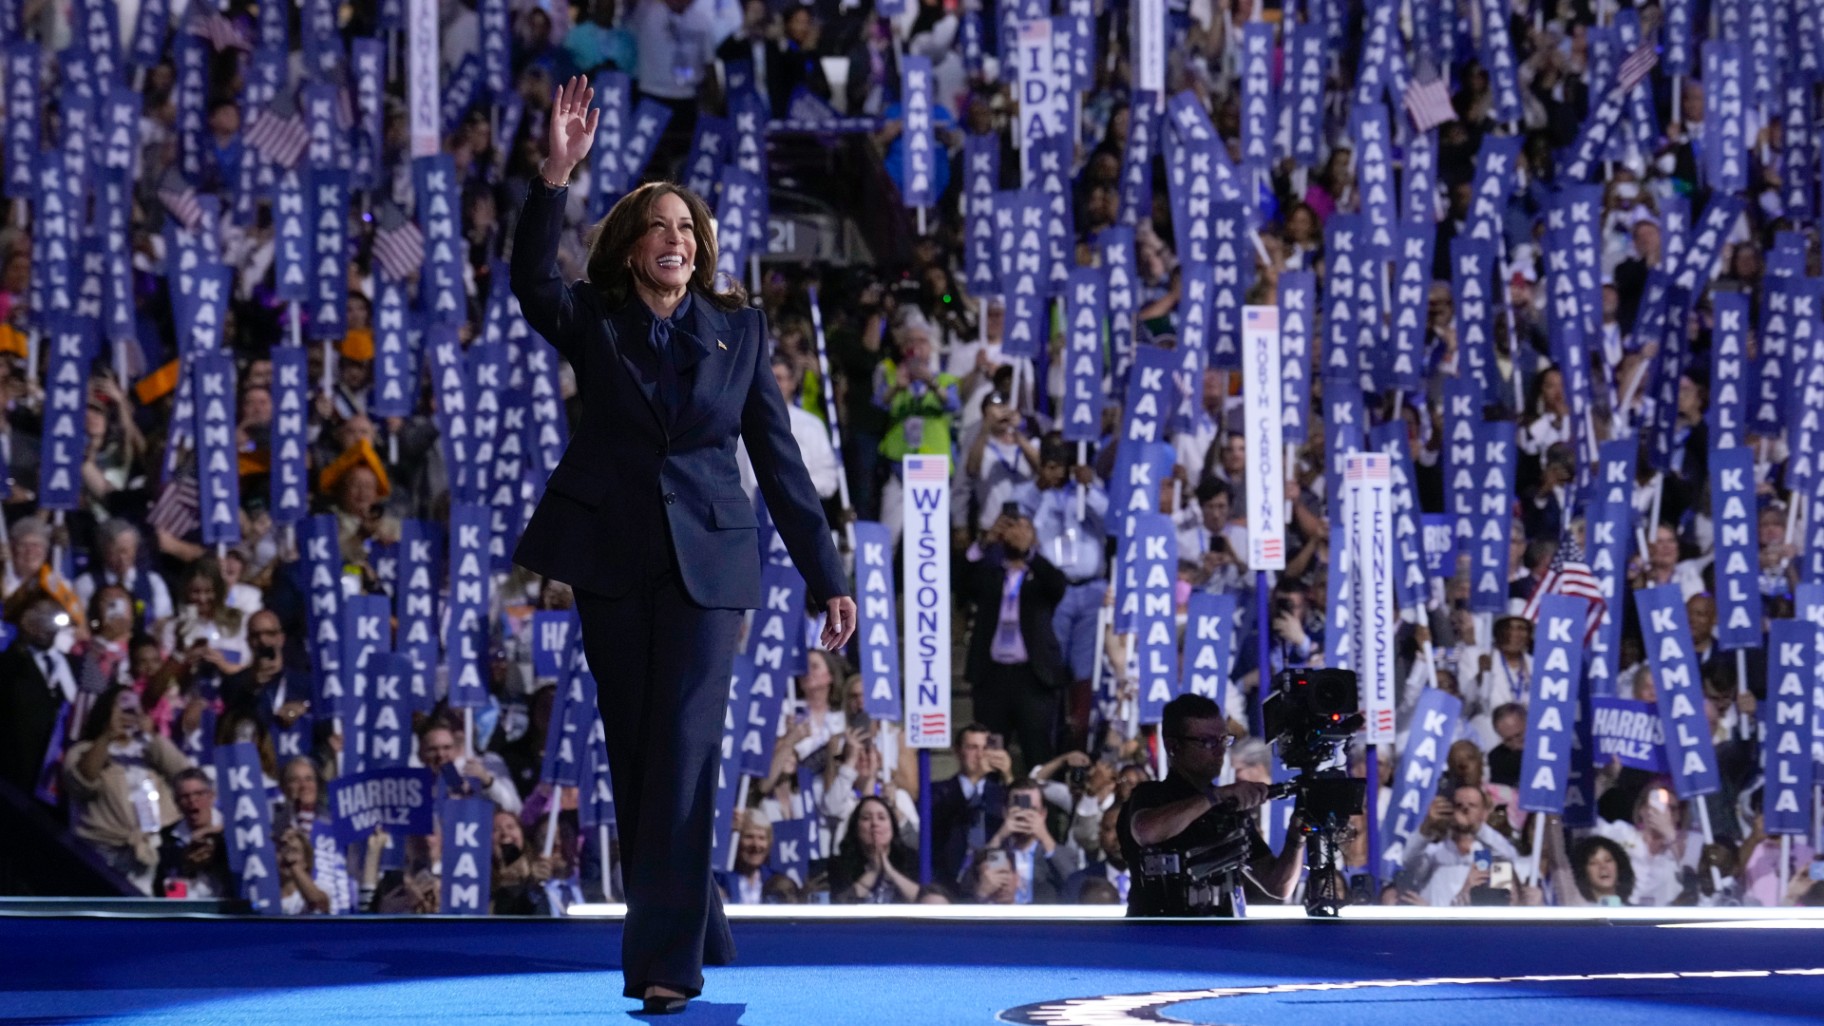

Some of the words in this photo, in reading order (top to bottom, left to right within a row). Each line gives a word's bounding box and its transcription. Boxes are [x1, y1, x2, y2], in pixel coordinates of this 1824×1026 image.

[483, 0, 506, 92] MALA
[1025, 47, 1047, 139] IDA
[1248, 36, 1268, 155] KAMALA
[1297, 38, 1320, 151] KAMALA
[1358, 5, 1392, 103] KAMAL
[1486, 0, 1518, 106] AMALA
[1751, 0, 1771, 92] AMALA
[12, 55, 33, 183] KAMALA
[600, 87, 621, 193] KAMAL
[622, 117, 657, 173] KAM
[688, 132, 720, 199] KAM
[908, 70, 928, 192] KAMALA
[1121, 104, 1150, 224] KAMALA
[1721, 58, 1741, 177] KAMALA
[41, 168, 70, 308] KAMALA
[279, 170, 305, 285] AMALA
[426, 170, 456, 312] KAMALA
[972, 153, 993, 282] KAMALA
[1189, 153, 1210, 261] KAMAL
[1361, 120, 1392, 247] KAMALA
[1472, 153, 1507, 240] KAMA
[78, 252, 103, 318] KAM
[317, 185, 342, 324] KAMALA
[1011, 206, 1042, 341] KAMALA
[1214, 219, 1237, 354] KAMALA
[1329, 230, 1354, 368] KAMALA
[1393, 237, 1425, 374] KAMALA
[1676, 207, 1730, 291] KAMA
[47, 333, 82, 491] KAMALA
[527, 349, 561, 471] KAMAL
[1072, 283, 1097, 424] KAMALA
[1128, 366, 1165, 443] KAM
[1282, 288, 1305, 427] KAMALA
[1717, 310, 1741, 448] KAMALA
[1758, 292, 1787, 422] KAMALA
[202, 373, 232, 524] KAMALA
[277, 364, 301, 509] KAMALA
[488, 406, 526, 557] KAMALA
[1452, 395, 1475, 538] KAMALA
[1478, 441, 1507, 593] KAMALA
[1720, 467, 1752, 629] KAMALA
[307, 536, 344, 699] KAMALA
[457, 524, 482, 688] KAMALA
[863, 541, 893, 701] KAMALA
[911, 487, 941, 707] WISCONSIN
[1145, 535, 1172, 703] KAMALA
[1190, 615, 1221, 699] KAM
[1372, 487, 1387, 700] TENNESSEE
[372, 675, 401, 760] KAM
[741, 585, 792, 756] KAMALA
[1530, 616, 1574, 791] KAMALA
[1592, 707, 1666, 746] HARRIS
[1650, 606, 1708, 777] KAMALA
[1774, 643, 1806, 813] KAMALA
[336, 778, 423, 819] HARRIS
[1382, 708, 1448, 867] KAMALA
[1600, 737, 1653, 761] WALZ
[227, 764, 271, 909] KAMAL
[351, 807, 411, 832] WALZ
[450, 822, 480, 909] KAM
